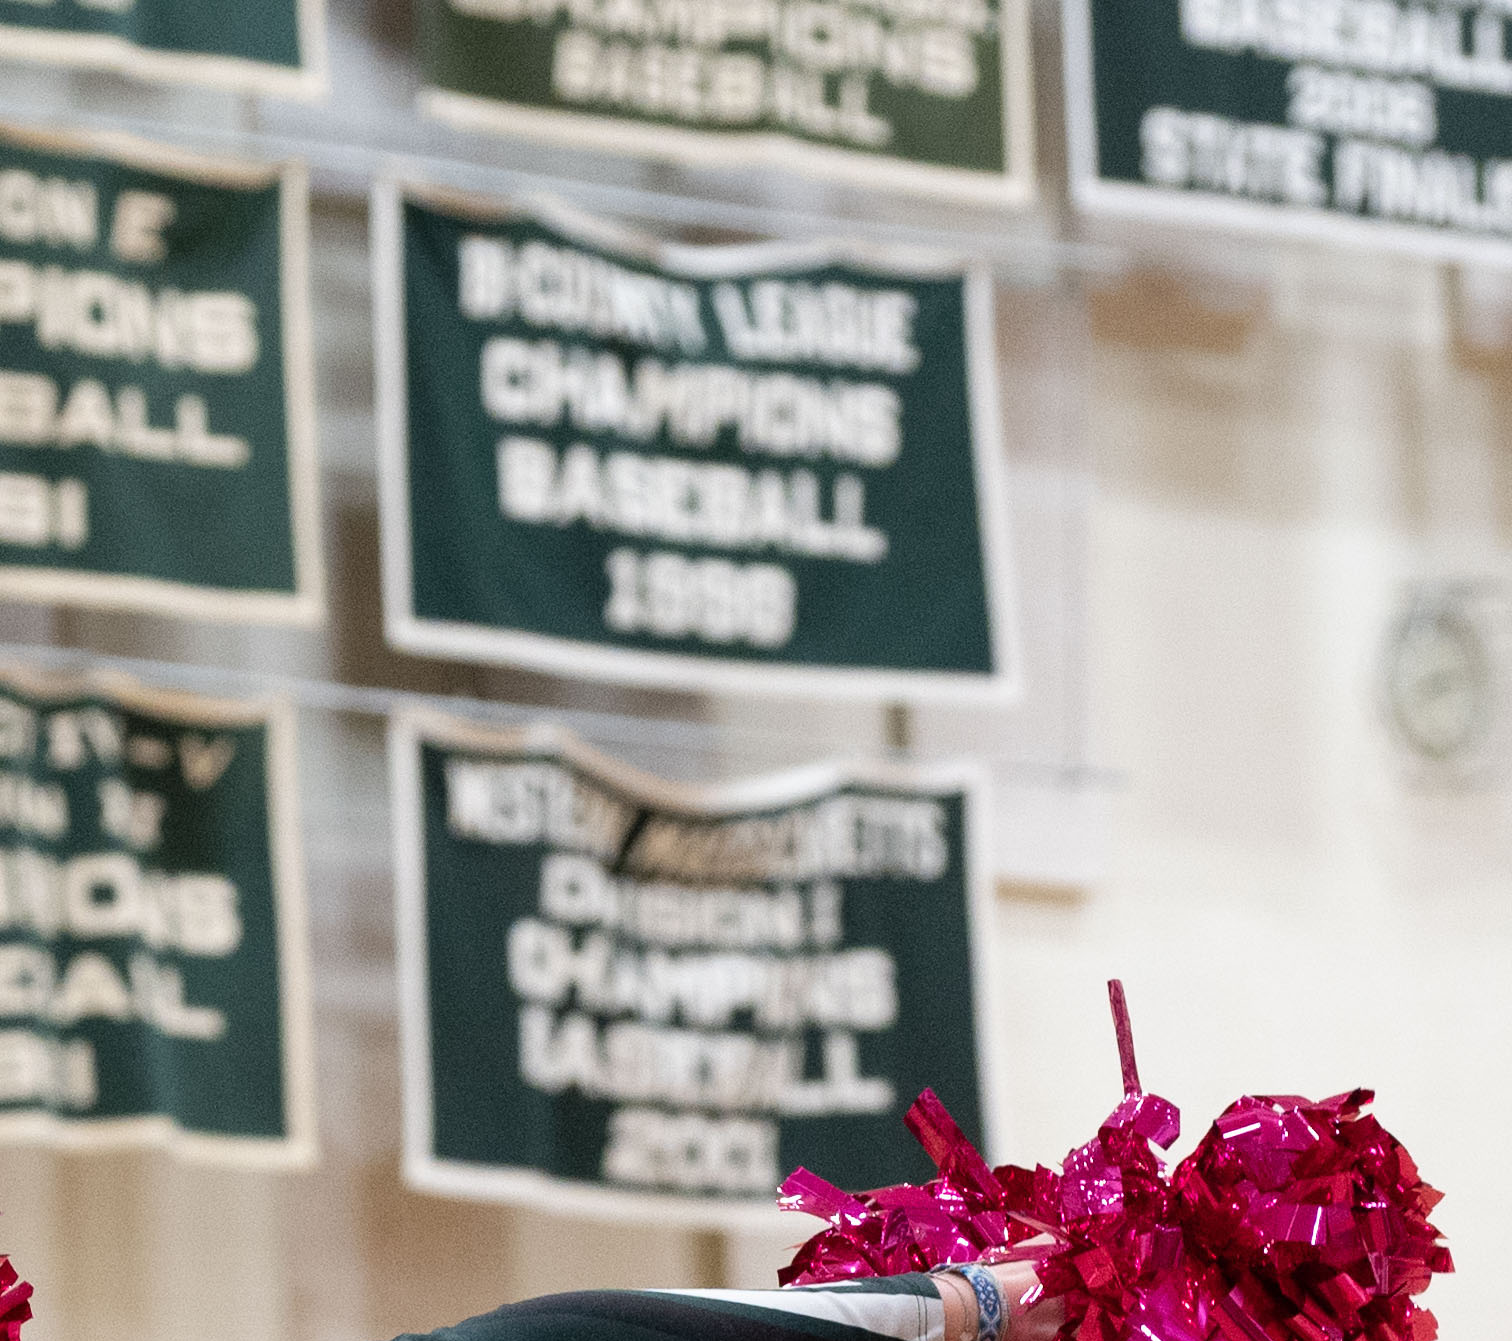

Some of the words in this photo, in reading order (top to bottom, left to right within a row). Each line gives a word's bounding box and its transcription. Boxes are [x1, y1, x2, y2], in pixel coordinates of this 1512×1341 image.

[1139, 105, 1326, 202] STATE
[481, 338, 902, 467] CHAMPIONS
[497, 436, 887, 563] BASEBALL
[506, 916, 898, 1031] CHAMPIONS
